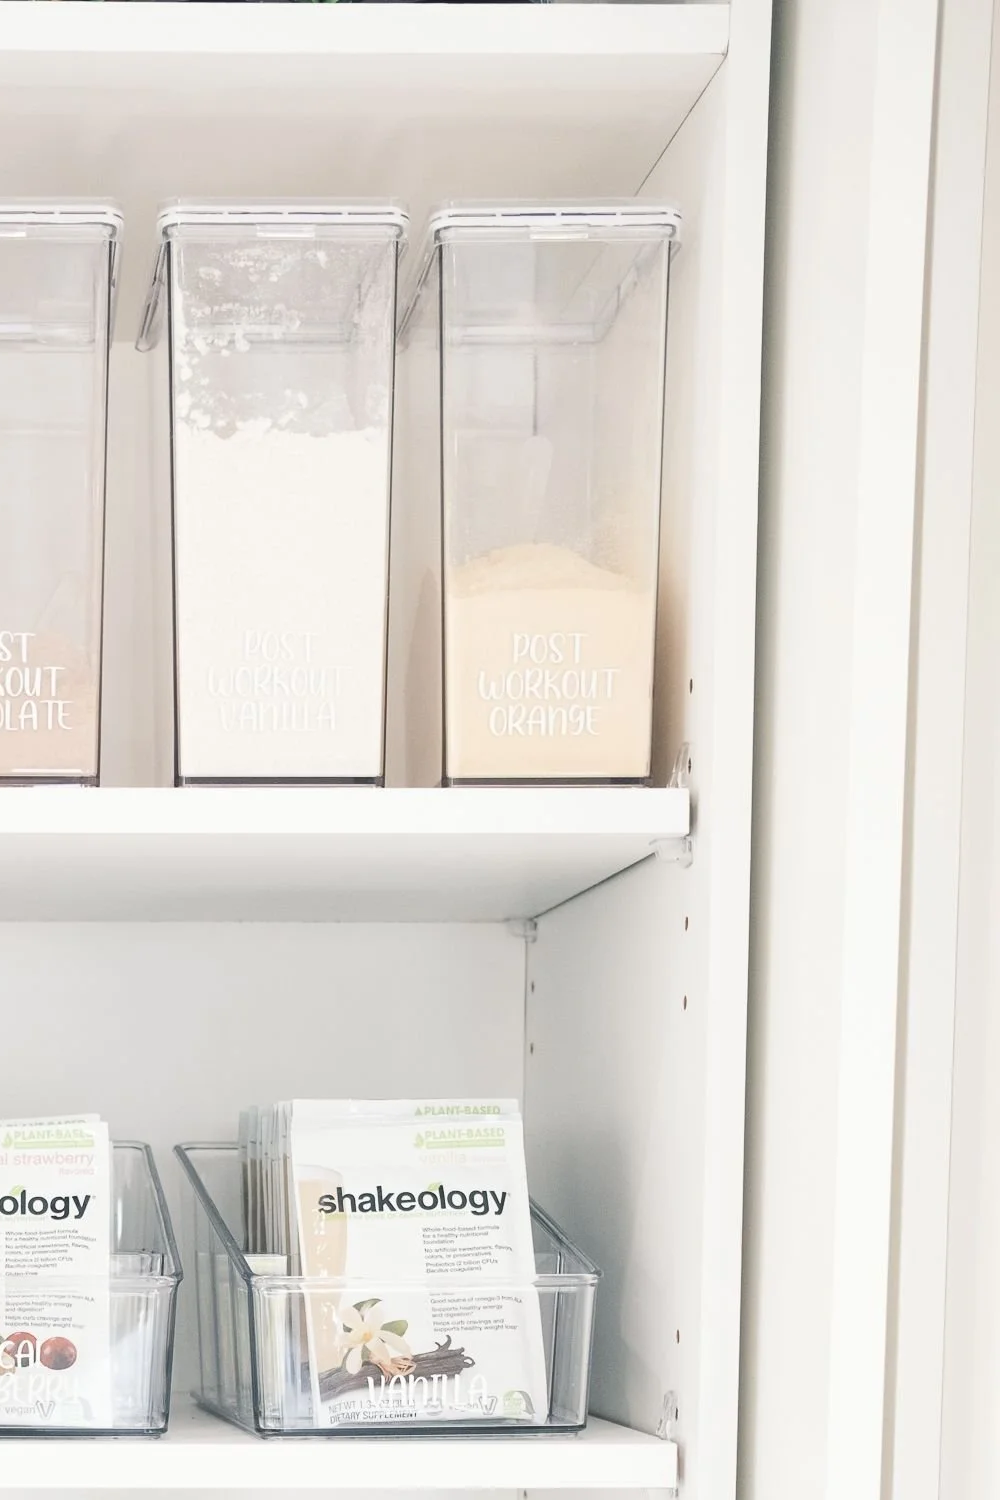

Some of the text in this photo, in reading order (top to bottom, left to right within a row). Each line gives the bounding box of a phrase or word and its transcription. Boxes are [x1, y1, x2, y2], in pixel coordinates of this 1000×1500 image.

[244, 629, 320, 664] POST
[513, 632, 590, 664] POST
[207, 663, 353, 697] WORKOUT
[479, 666, 621, 701] WORKOUT
[220, 700, 336, 732] VANILLA
[489, 702, 602, 736] ORANGE
[423, 1105, 502, 1116] PLANT-BASED
[14, 1128, 94, 1142] PLANT-BASE
[424, 1126, 505, 1141] PLANT-BASED
[13, 1150, 94, 1167] strawberry
[318, 1183, 507, 1217] shakeology
[367, 1373, 488, 1406] VANILLA
[4, 1405, 36, 1417] vegan
[329, 1410, 360, 1425] DIETARY
